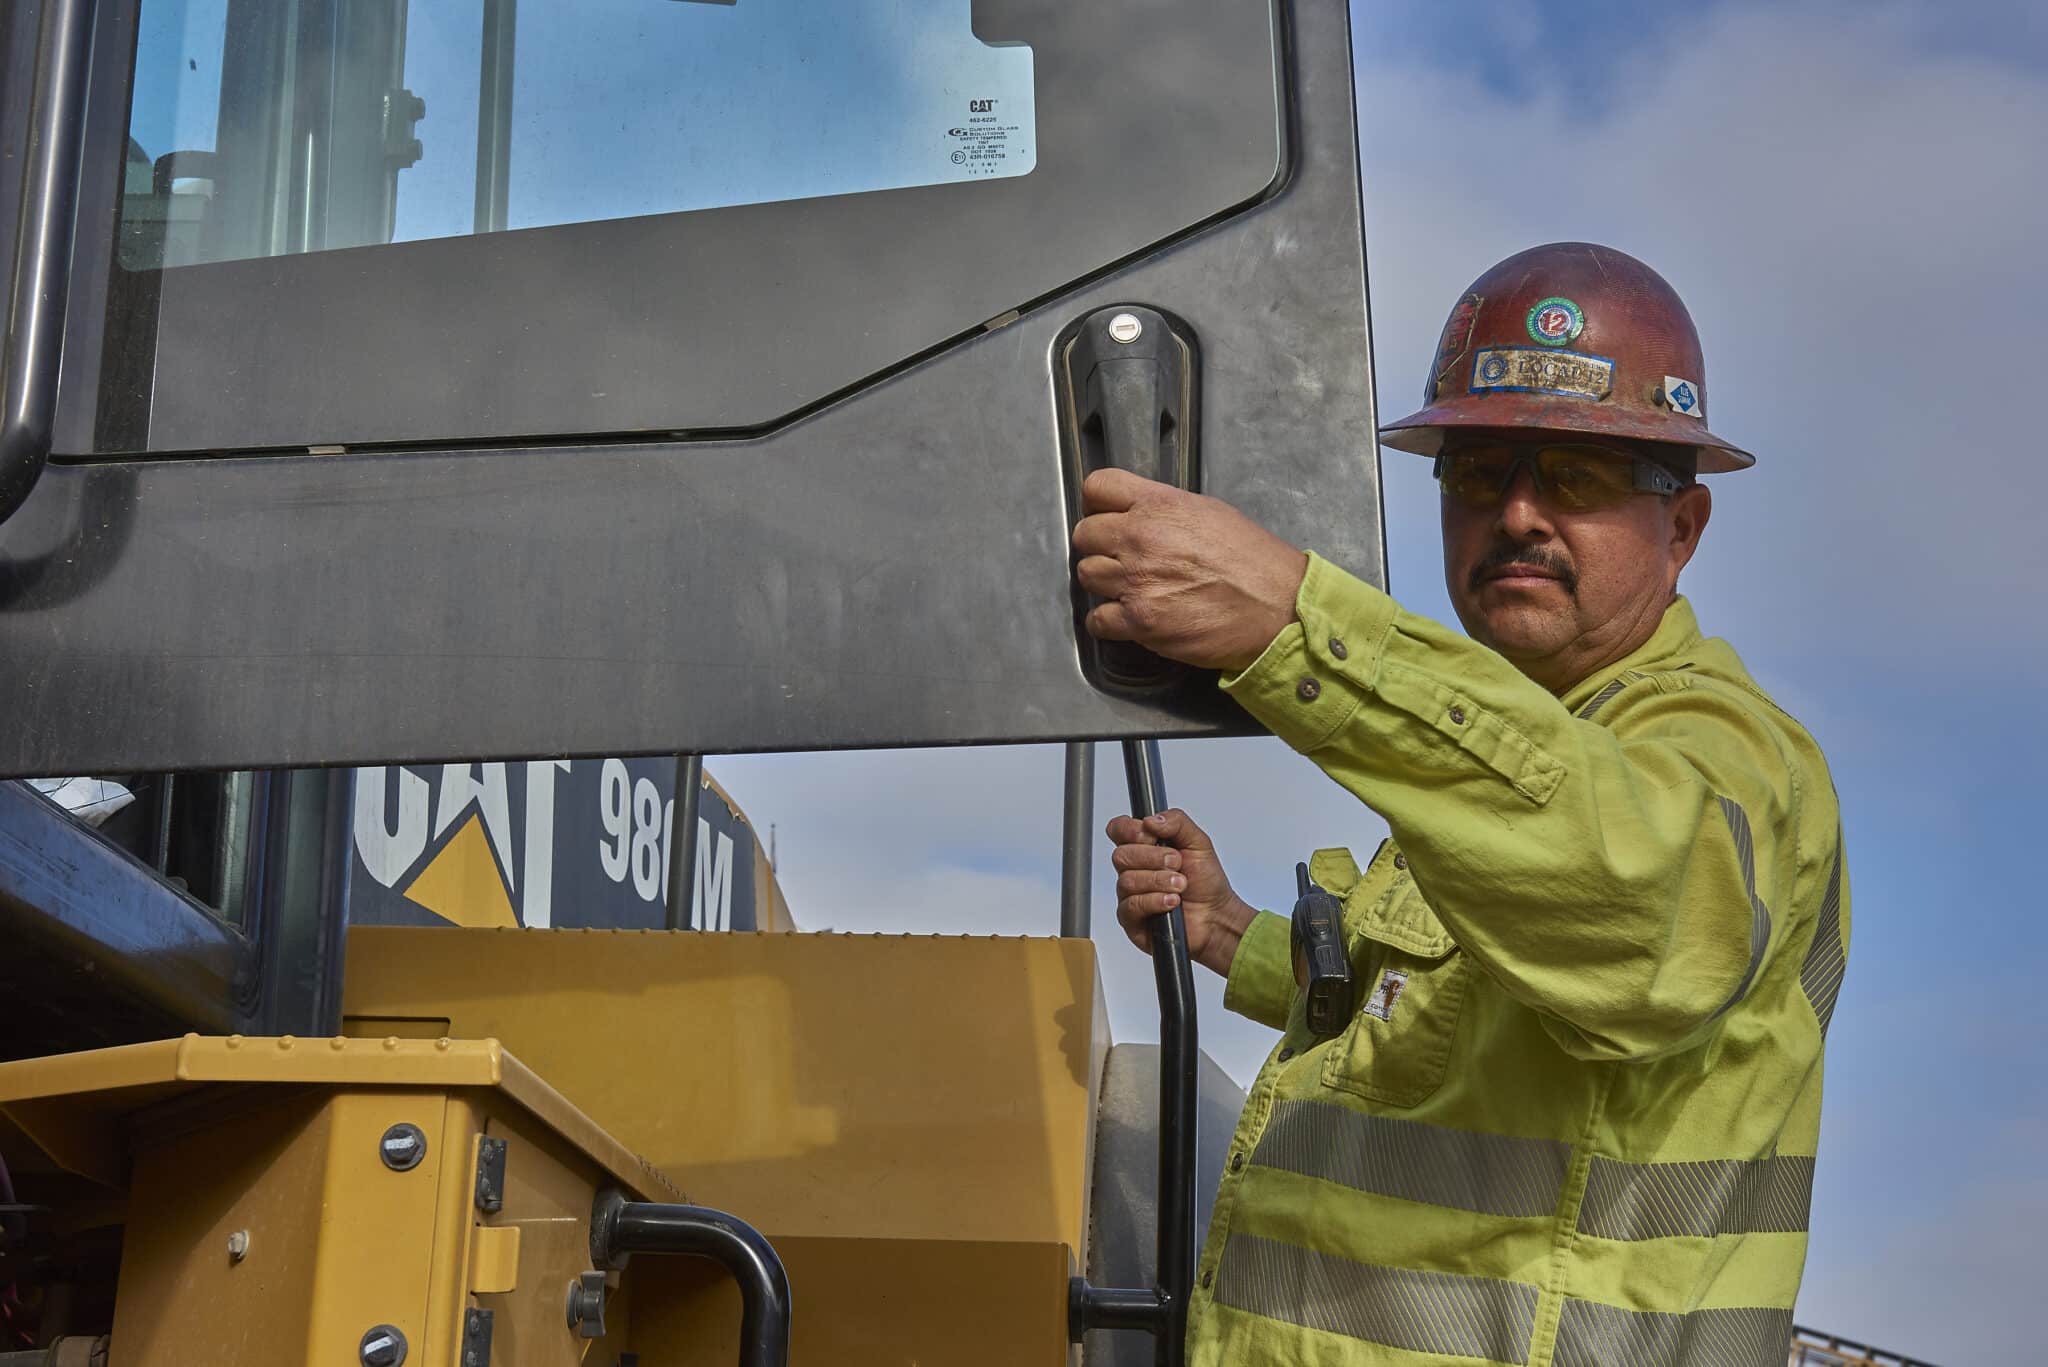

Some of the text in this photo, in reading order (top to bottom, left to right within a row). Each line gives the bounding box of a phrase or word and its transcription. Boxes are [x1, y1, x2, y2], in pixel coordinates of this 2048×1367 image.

[970, 99, 994, 113] CAT
[1542, 312, 1567, 331] 12
[1588, 370, 1605, 385] 12
